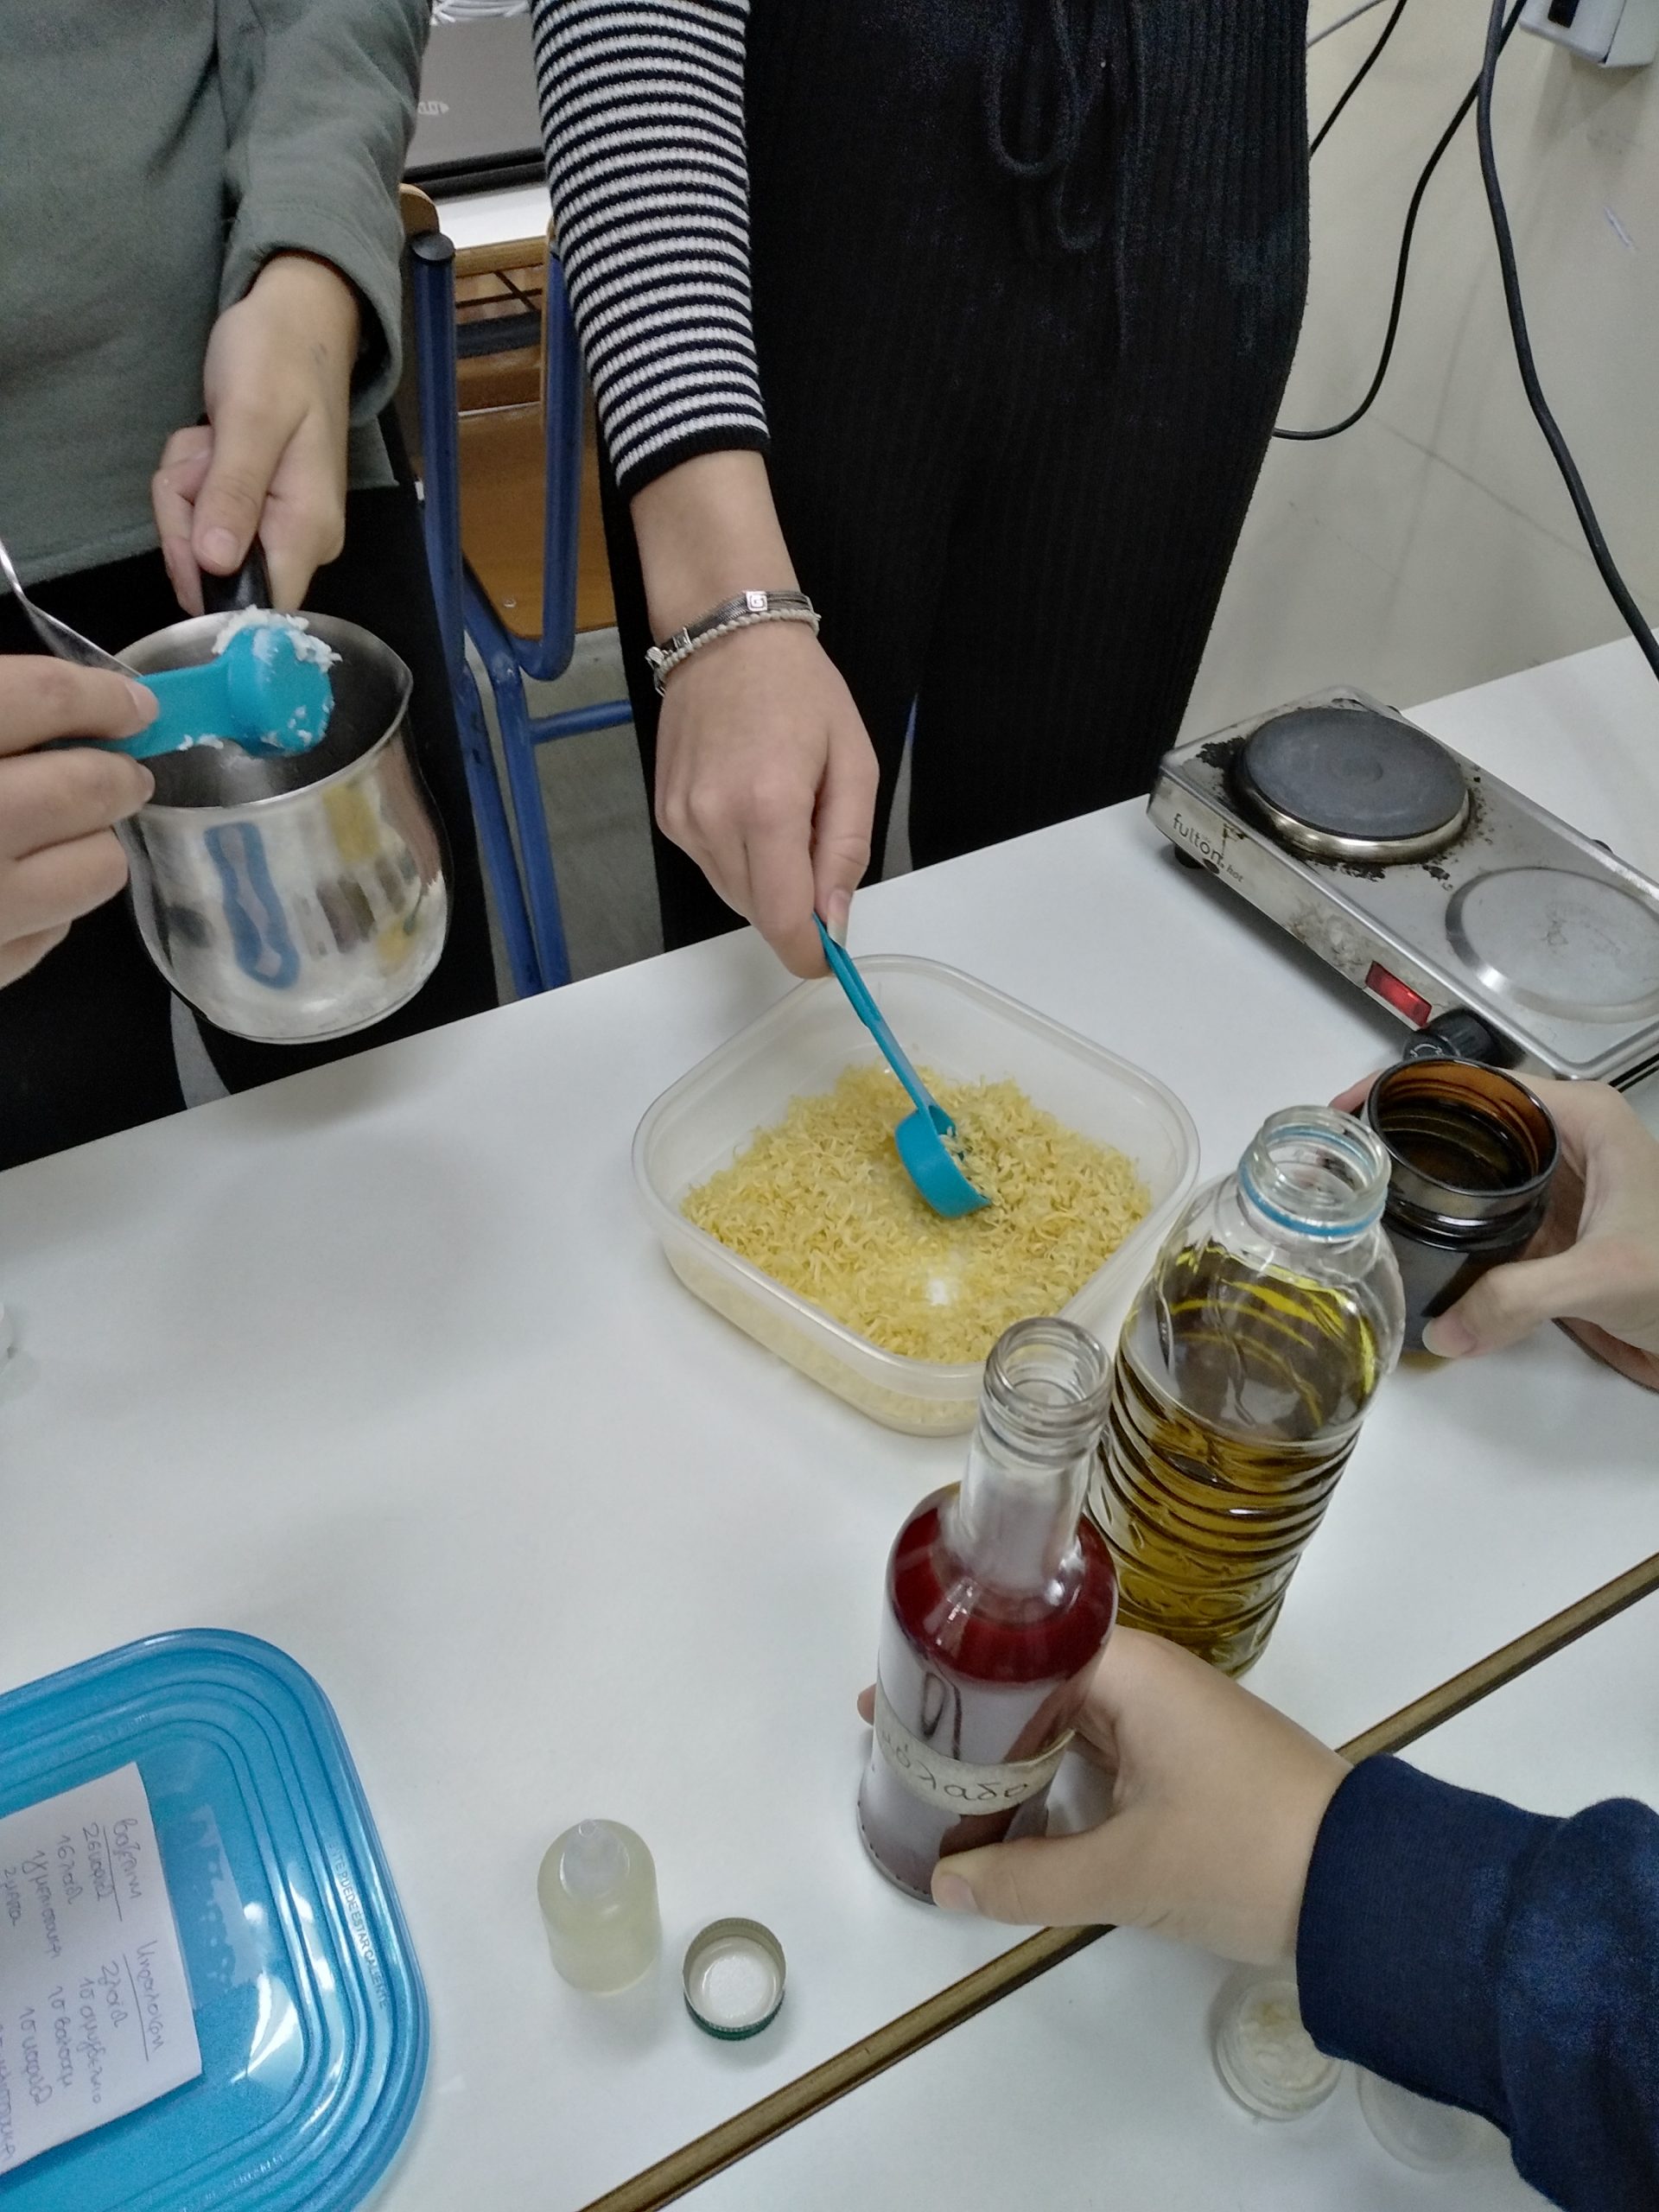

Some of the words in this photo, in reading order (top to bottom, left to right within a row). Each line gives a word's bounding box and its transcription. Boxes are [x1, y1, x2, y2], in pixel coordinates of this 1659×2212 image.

[340, 1870, 359, 1910] PUEDE
[351, 1910, 371, 1950] ESTAR
[364, 1949, 389, 2009] CALIENTE
